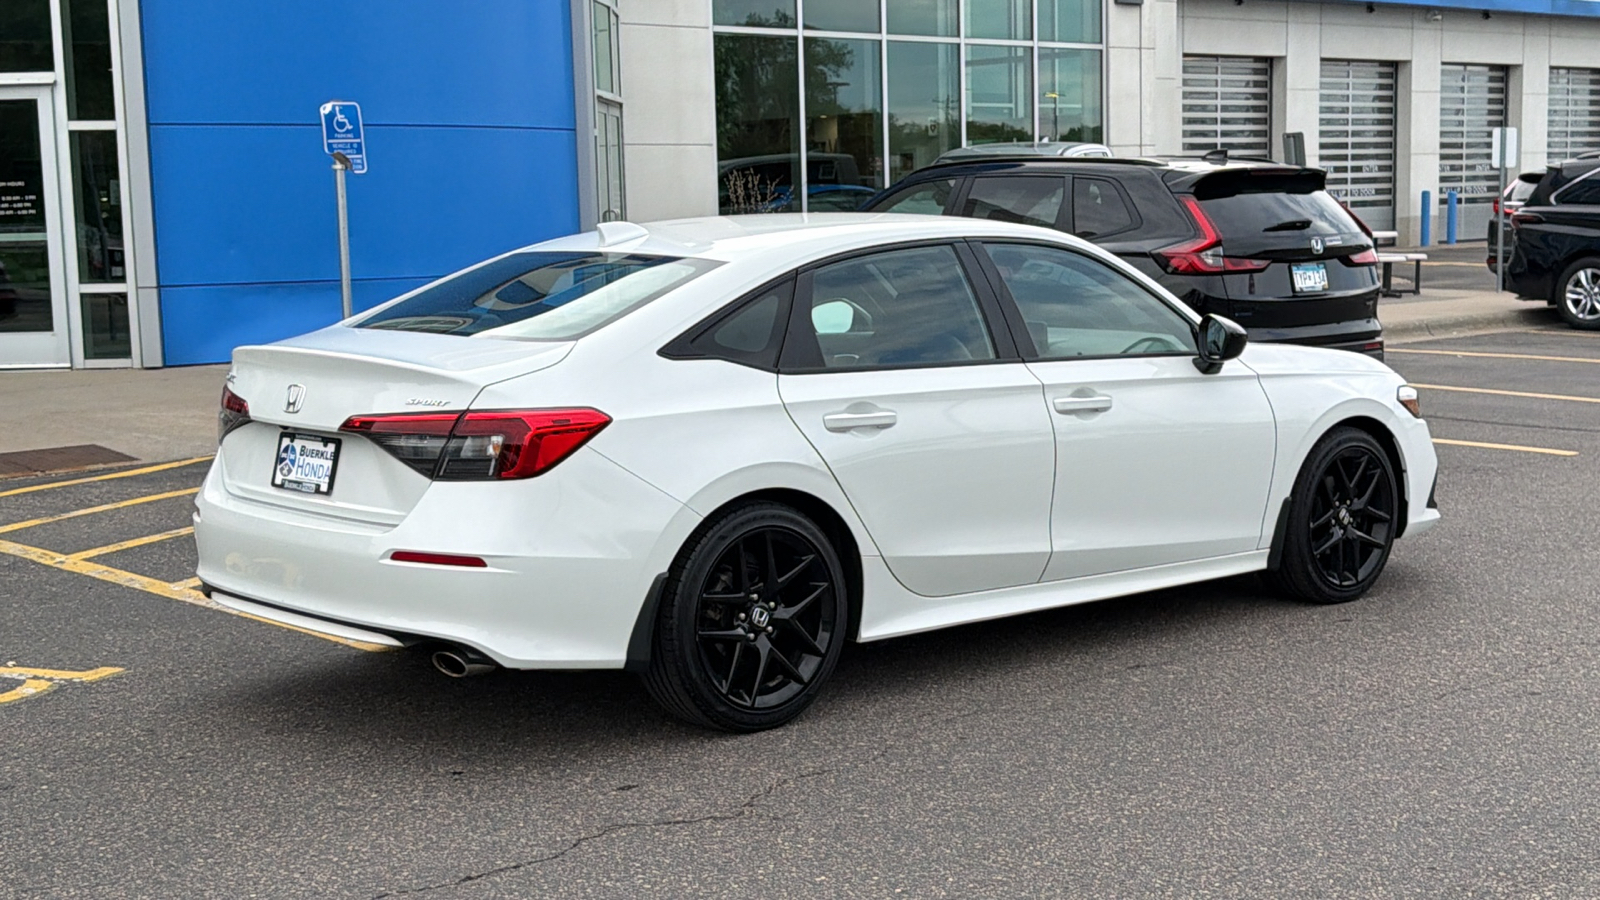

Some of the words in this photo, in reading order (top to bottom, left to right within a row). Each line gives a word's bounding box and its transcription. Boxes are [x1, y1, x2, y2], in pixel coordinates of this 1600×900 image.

[405, 398, 451, 407] SPORT
[299, 445, 335, 460] BUERKLE
[296, 458, 330, 480] HONDA
